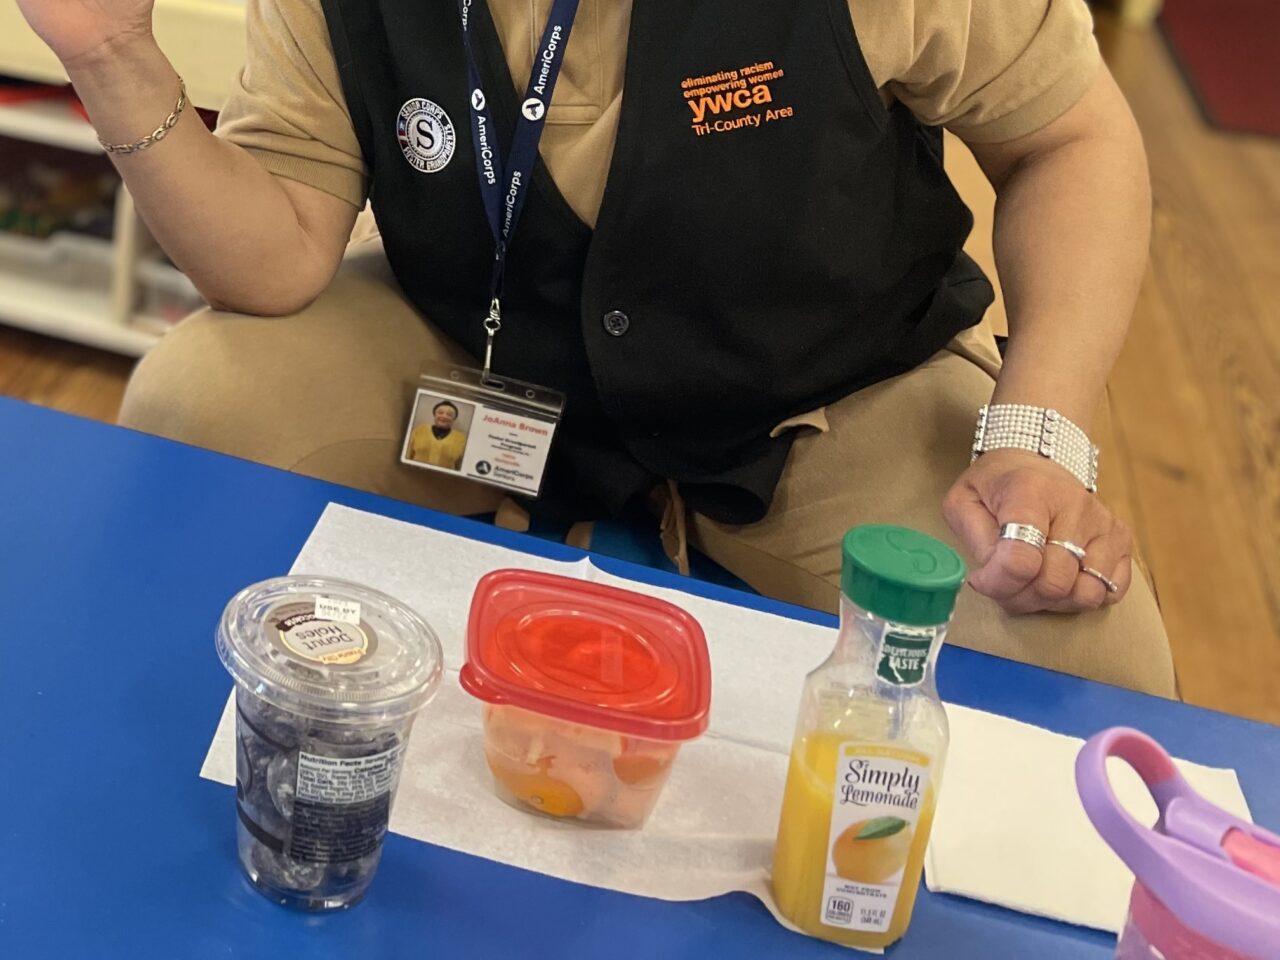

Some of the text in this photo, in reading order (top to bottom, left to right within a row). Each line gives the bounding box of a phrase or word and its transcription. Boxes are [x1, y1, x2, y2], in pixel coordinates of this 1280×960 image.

[533, 25, 562, 95] AmeriCorps
[681, 61, 773, 88] eliminating racism
[683, 69, 784, 98] empowering women
[401, 101, 444, 119] SENIOR CORPS
[688, 84, 772, 123] ywca
[416, 120, 434, 149] S
[691, 106, 793, 136] Tri-County Area
[477, 115, 496, 185] AmeriCorps
[502, 171, 522, 238] AmeriCorps
[295, 625, 342, 640] Holes
[302, 633, 353, 650] Donut
[300, 753, 338, 766] Nutrition
[845, 759, 920, 795] Simply
[840, 784, 918, 810] Lemonade
[832, 900, 851, 912] 160
